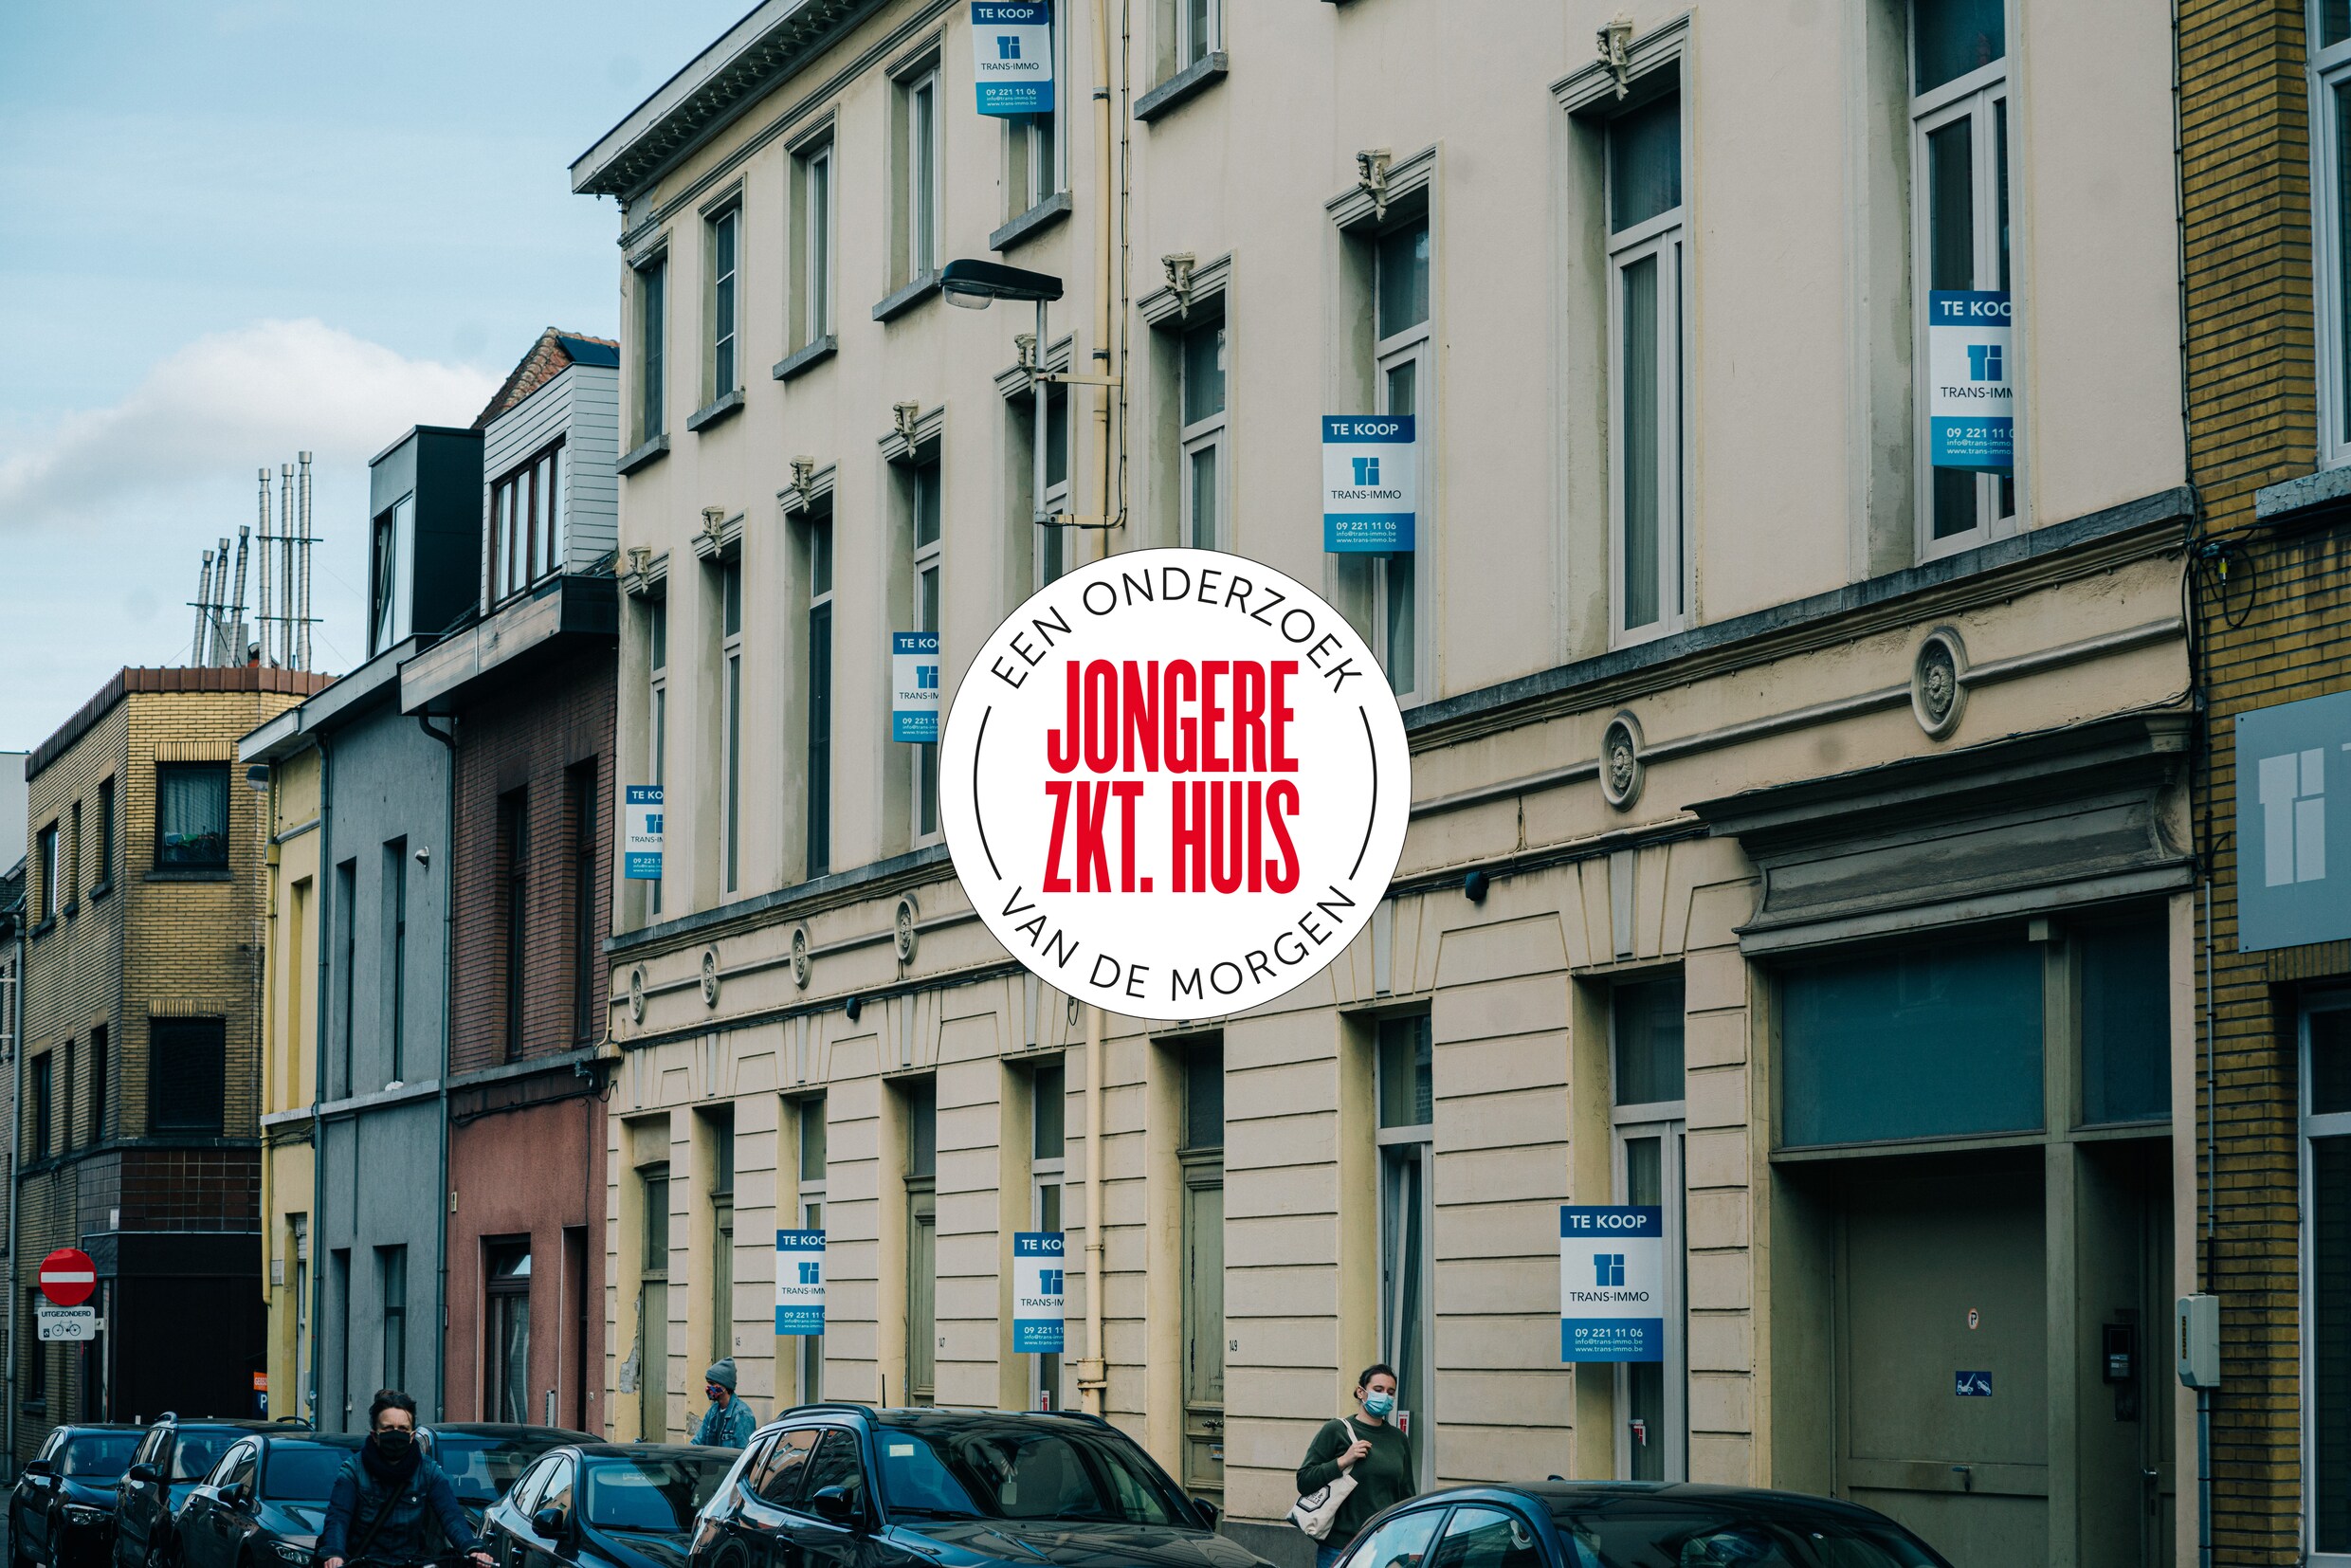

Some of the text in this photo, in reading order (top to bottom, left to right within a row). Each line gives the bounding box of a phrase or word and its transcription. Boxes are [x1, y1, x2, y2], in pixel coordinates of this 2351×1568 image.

[978, 9, 1034, 18] TE KOOP
[1941, 301, 1963, 316] TE
[1331, 424, 1398, 435] TE KOOP
[1947, 428, 1961, 438] 09
[1966, 428, 1987, 438] 221
[1992, 428, 2004, 438] 11
[1331, 490, 1401, 500] TRANS-IMMO
[900, 638, 939, 648] TE KO
[632, 791, 645, 799] TE
[1570, 1215, 1647, 1229] TE KOOP
[783, 1235, 796, 1245] TE
[1022, 1239, 1065, 1250] TE KO
[1570, 1291, 1649, 1302] TRANS-IMMO
[1575, 1328, 1643, 1338] 09 221 11 06
